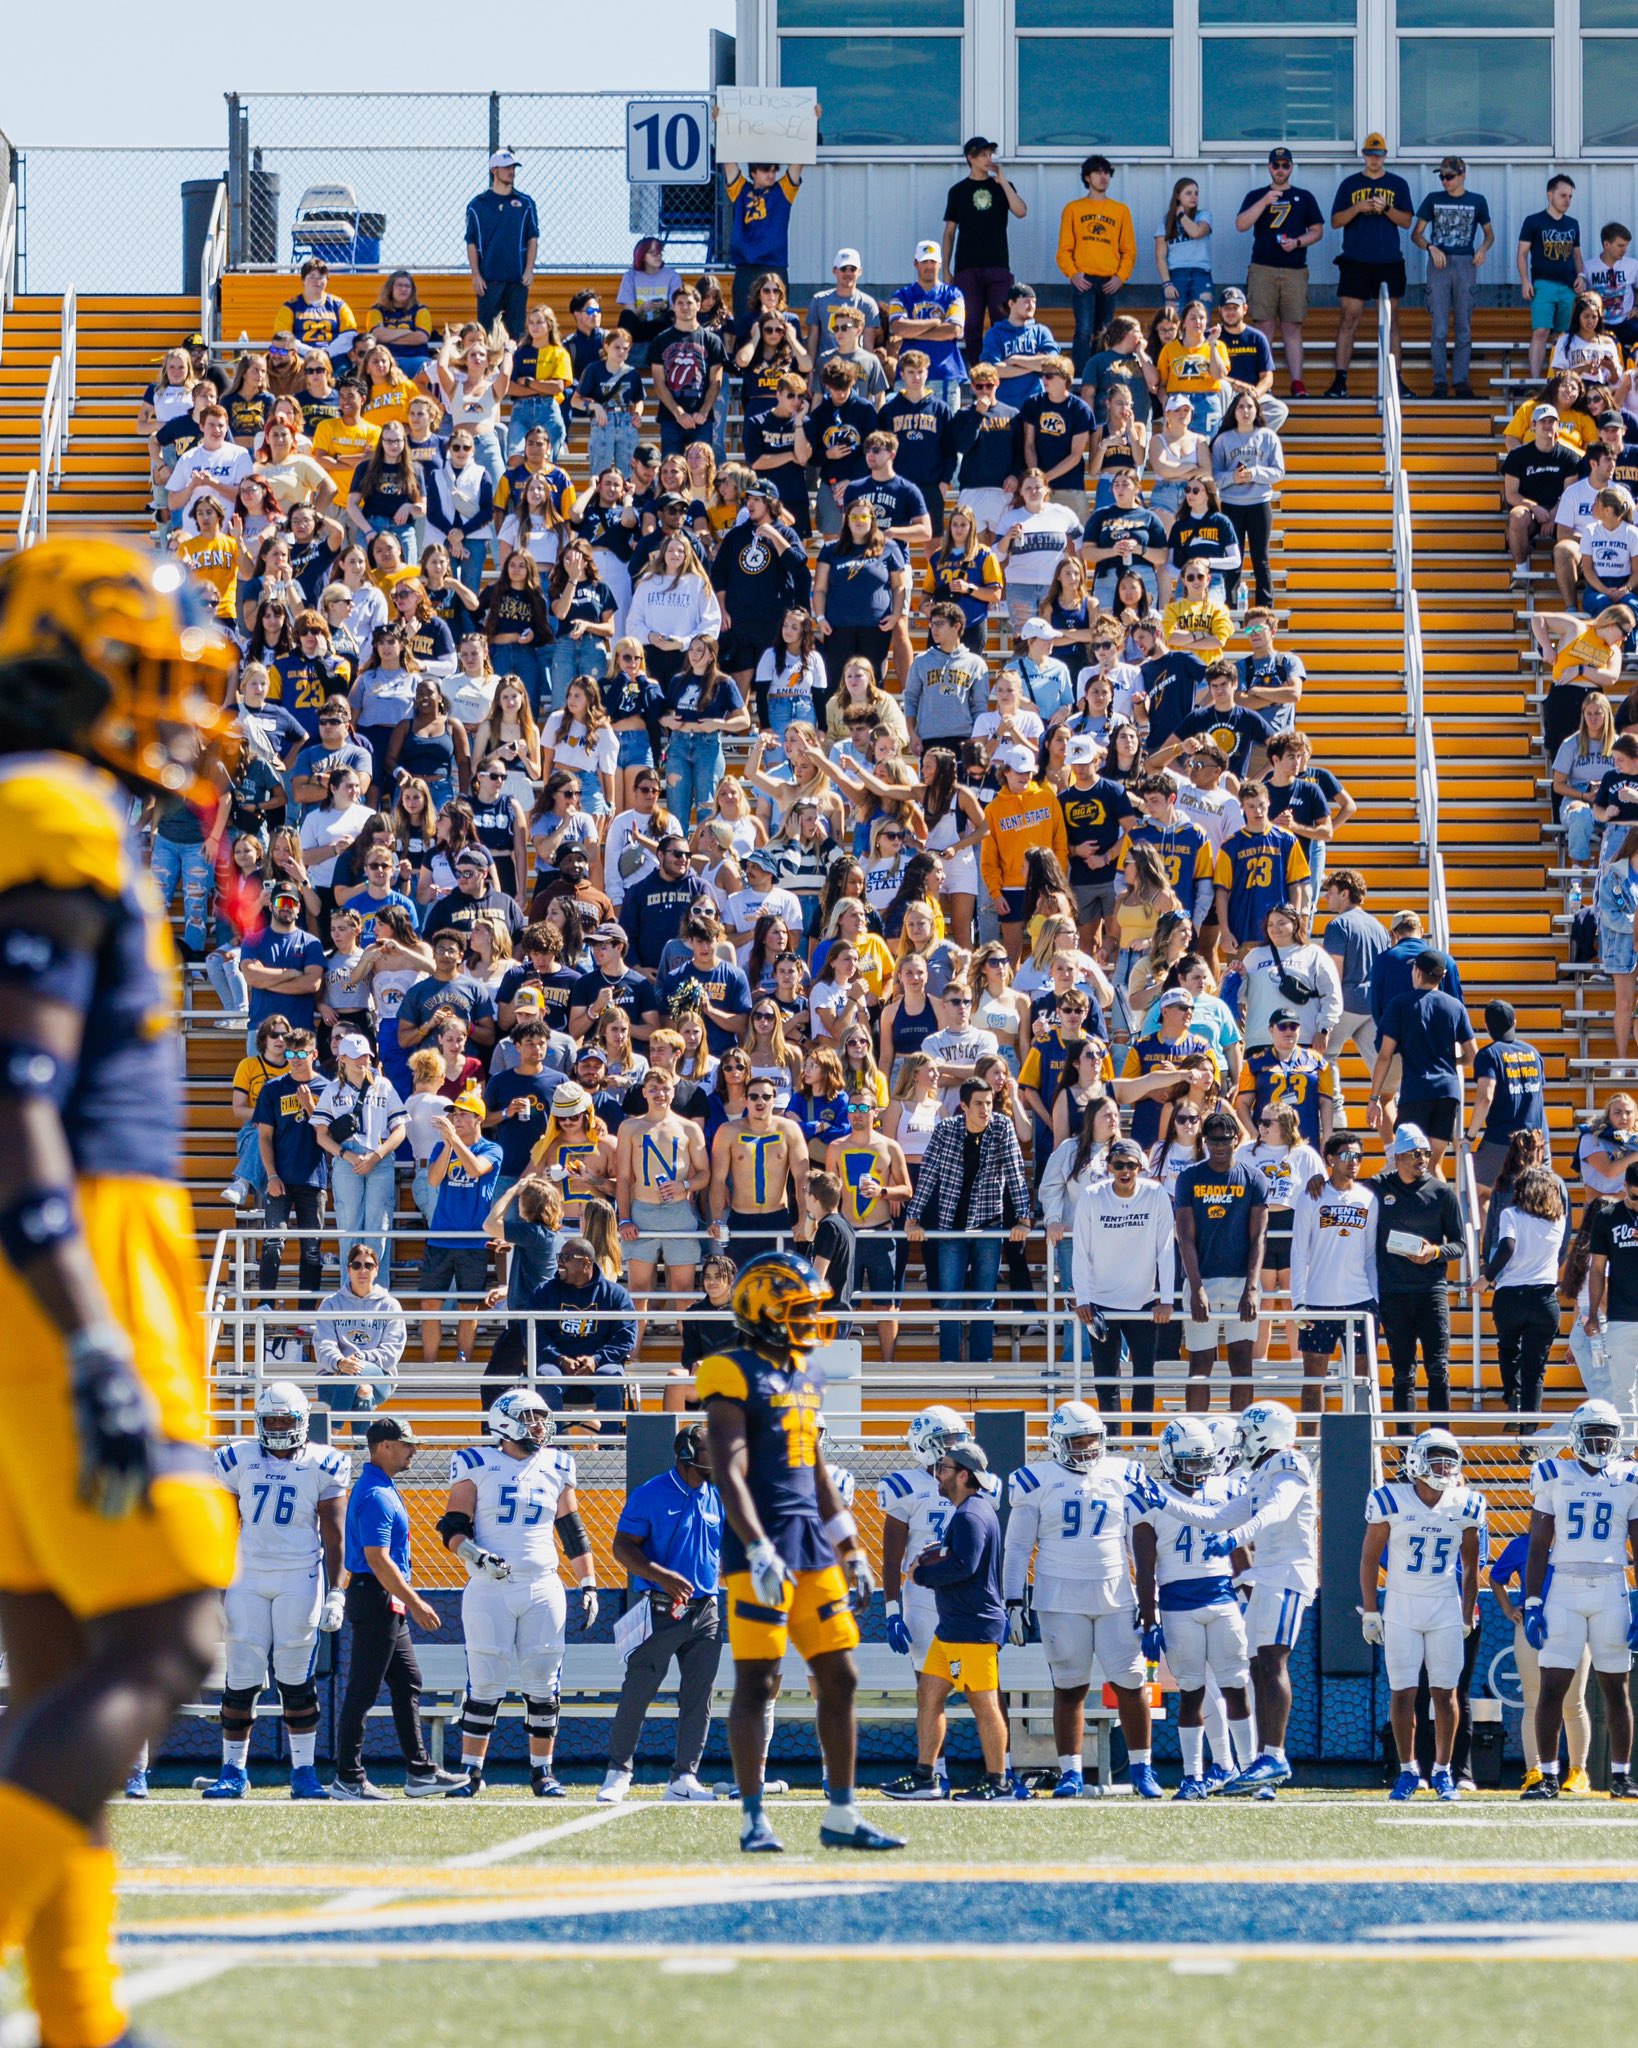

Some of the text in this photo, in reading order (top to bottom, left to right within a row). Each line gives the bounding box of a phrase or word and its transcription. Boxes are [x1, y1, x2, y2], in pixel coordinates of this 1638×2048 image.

[720, 110, 764, 136] The
[633, 113, 700, 171] 10
[1350, 188, 1370, 203] KENT
[1080, 214, 1116, 226] KENT STATE
[1269, 204, 1292, 228] 7
[302, 319, 332, 342] 23
[878, 493, 897, 507] STATE
[1198, 527, 1219, 541] STATE
[1609, 540, 1627, 550] STATE
[191, 550, 233, 569] KENT
[667, 592, 690, 605] STATE
[927, 668, 971, 688] KENT STATE
[294, 680, 325, 709] 23
[999, 807, 1050, 832] KENT STATE
[1165, 843, 1191, 855] FLASHES
[1237, 844, 1281, 860] GOLDEN FLASHES
[1246, 856, 1272, 888] 23
[1269, 1074, 1307, 1105] 23
[332, 1096, 359, 1108] KENT
[557, 1131, 782, 1207] E N T
[1194, 1185, 1245, 1198] READY TO
[1202, 1194, 1233, 1204] DANCE
[1100, 1213, 1150, 1223] KENT STATE
[1330, 1206, 1357, 1217] KENT
[1104, 1220, 1145, 1229] BASKETBALL
[1337, 1215, 1367, 1228] STATE
[354, 1333, 366, 1343] K
[265, 1473, 287, 1481] CCSU
[252, 1484, 295, 1527] 76
[497, 1486, 544, 1526] 55
[1061, 1500, 1108, 1539] 97
[1567, 1501, 1614, 1542] 58
[1406, 1535, 1455, 1574] 35
